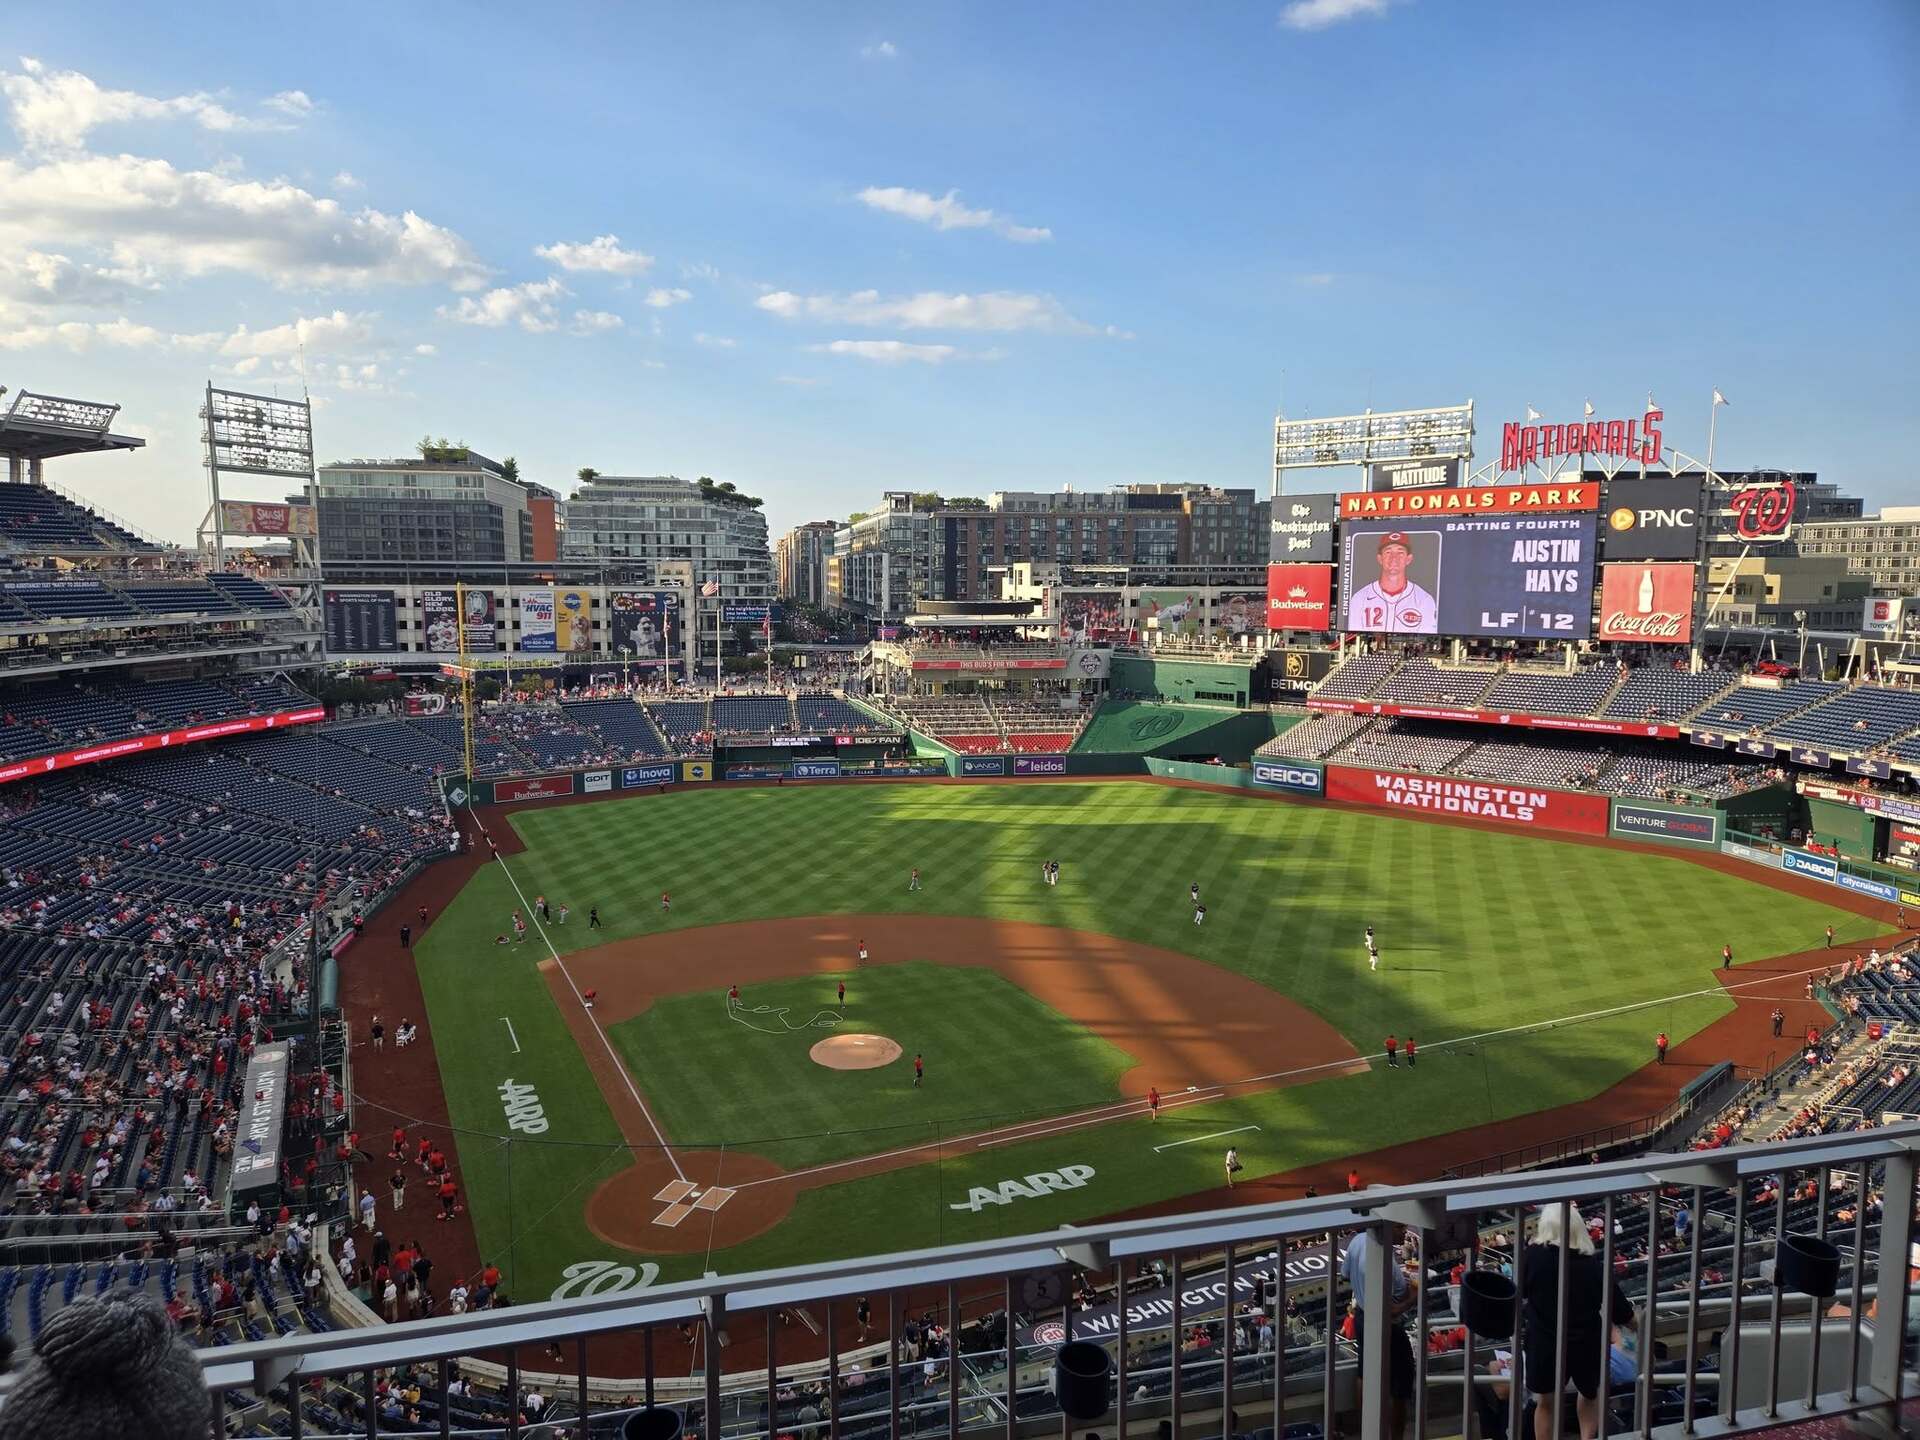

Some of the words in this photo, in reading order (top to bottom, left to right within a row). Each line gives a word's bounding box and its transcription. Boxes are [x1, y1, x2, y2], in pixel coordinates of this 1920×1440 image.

[1501, 411, 1663, 471] NATIONALS
[1392, 465, 1447, 487] NATITUDE
[1348, 492, 1495, 512] NATIONALS
[1509, 488, 1584, 505] PARK
[256, 508, 285, 521] SMASH
[1291, 504, 1311, 517] The
[1638, 508, 1694, 528] PNC
[1271, 519, 1331, 535] Washington
[1446, 522, 1511, 531] BATTING
[1516, 520, 1580, 530] FOURTH
[1288, 537, 1312, 552] Post
[1511, 539, 1580, 562] AUSTIN
[1525, 569, 1579, 592] HAYS
[1271, 599, 1325, 610] Budweiser
[536, 612, 552, 620] 911
[1364, 607, 1384, 627] 12
[1481, 611, 1519, 628] LF
[1540, 613, 1574, 630] 12
[1531, 719, 1578, 728] WASHINGTON
[1579, 722, 1622, 731] NATIONALS
[640, 768, 670, 779] Inova
[809, 766, 836, 774] Terra
[1030, 760, 1063, 772] leidos
[1256, 766, 1318, 786] GEICO
[514, 790, 555, 800] Budweiser
[1375, 774, 1547, 808] WASHINGTON
[1386, 790, 1535, 821] NATIONALS
[1620, 815, 1666, 829] VENTURE
[1667, 821, 1708, 833] GLOBAL
[1841, 876, 1884, 894] citycruises
[497, 1079, 549, 1134] AARP
[950, 1165, 1096, 1212] AARP
[1037, 1281, 1047, 1297] 5
